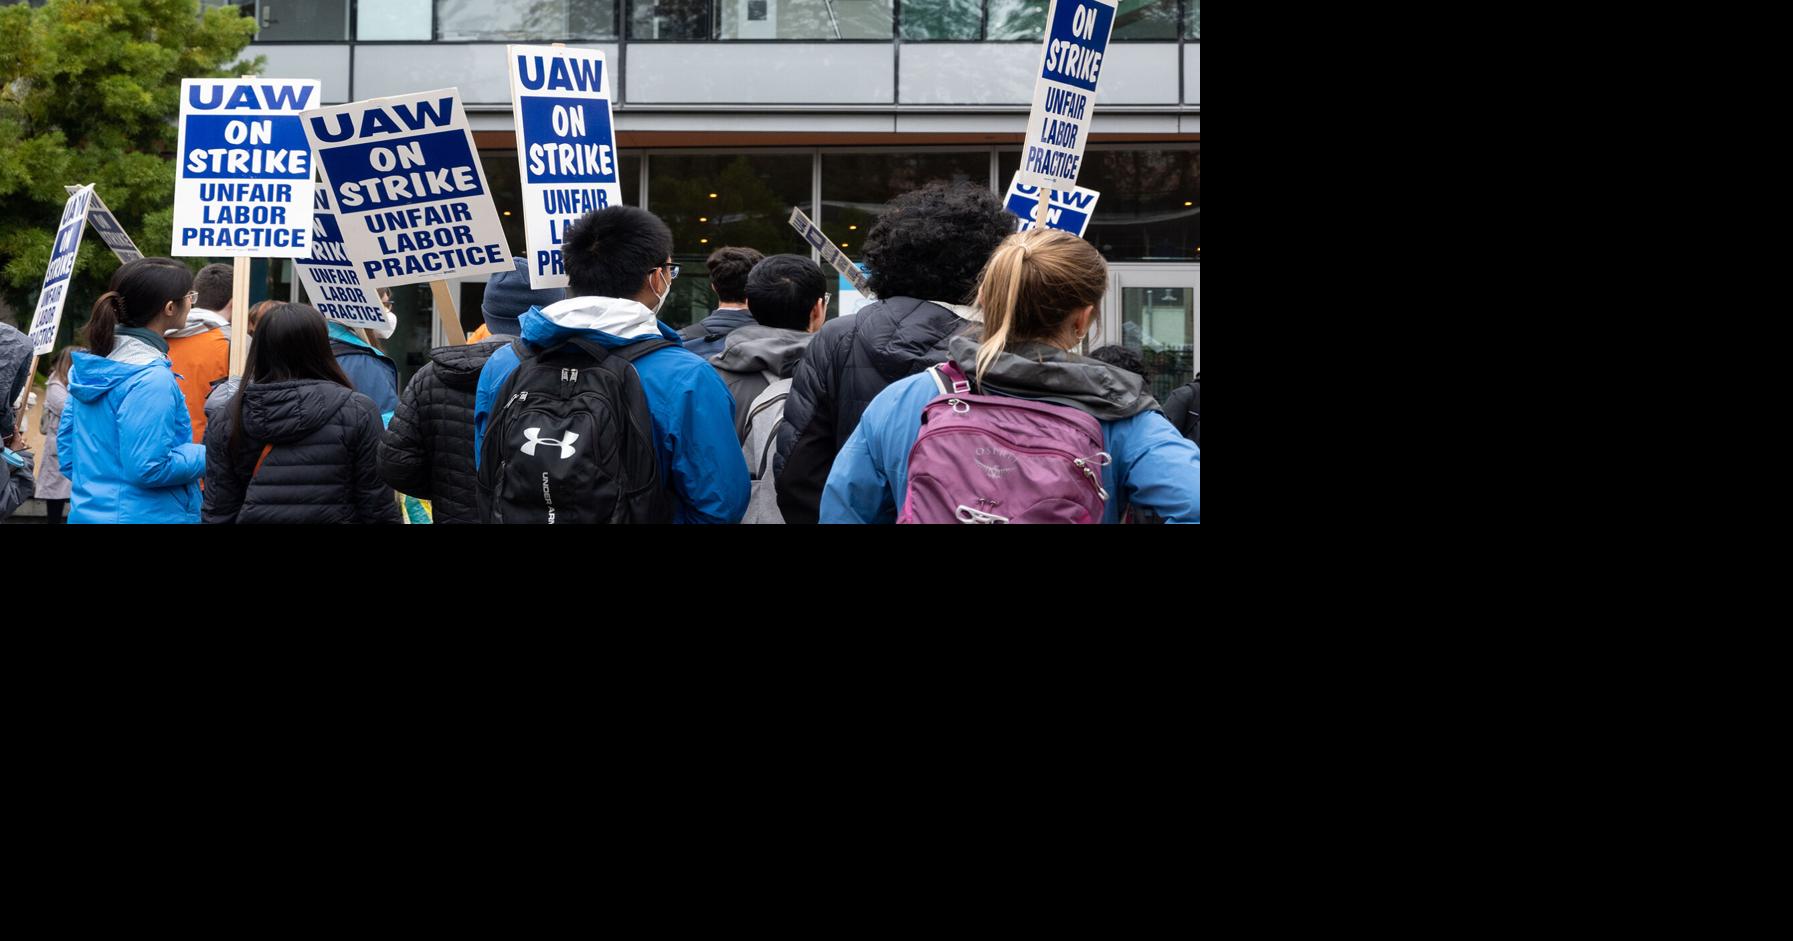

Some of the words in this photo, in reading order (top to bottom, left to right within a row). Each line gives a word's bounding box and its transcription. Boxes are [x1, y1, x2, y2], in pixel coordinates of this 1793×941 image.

[1072, 4, 1097, 41] ON
[517, 55, 602, 92] UAW
[1046, 38, 1102, 83] STRIKE
[189, 85, 314, 110] UAW
[1045, 87, 1087, 120] UNFAIR
[224, 120, 272, 145] ON
[310, 97, 453, 142] UAW
[552, 105, 586, 137] ON
[1040, 117, 1078, 149] LABOR
[187, 149, 307, 174] STRIKE
[370, 141, 425, 172] ON
[529, 143, 613, 176] STRIKE
[1025, 146, 1080, 180] PRACTICE
[200, 183, 292, 202] UNFAIR
[339, 166, 477, 207] STRIKE
[543, 189, 608, 214] UNFAIR
[203, 205, 286, 224] LABOR
[364, 202, 472, 234] UNFAIR
[182, 228, 306, 247] PRACTICE
[377, 225, 474, 255] LABOR
[309, 268, 360, 285] UNFAIR
[363, 244, 505, 279] PRACTICE
[320, 286, 367, 303] LABOR
[317, 303, 385, 322] PRACTICE
[542, 471, 552, 505] UNDER
